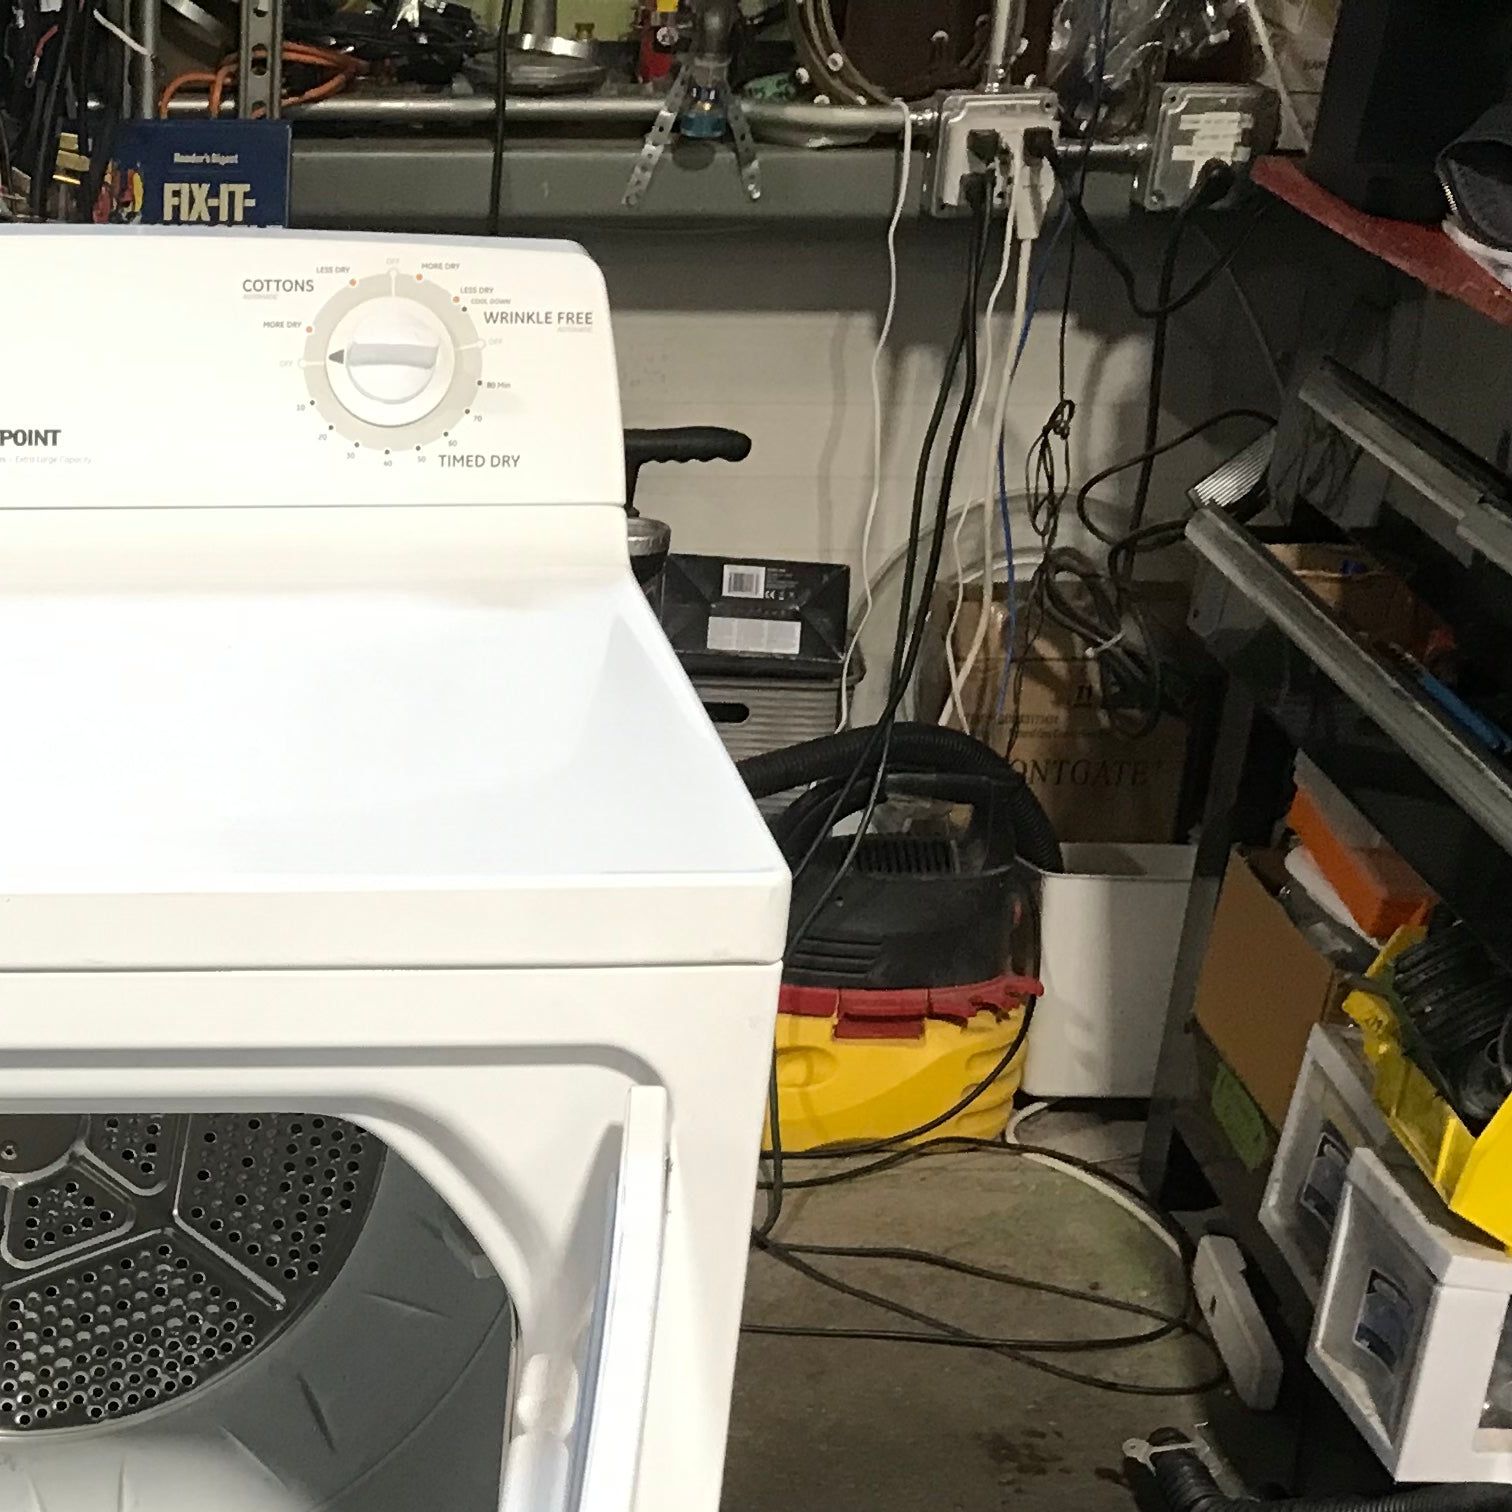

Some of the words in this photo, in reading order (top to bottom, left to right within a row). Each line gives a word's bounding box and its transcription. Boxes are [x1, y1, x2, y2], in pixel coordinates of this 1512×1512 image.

[316, 265, 334, 274] LESS
[335, 266, 351, 274] DRY
[421, 262, 444, 271] MORE
[445, 262, 461, 271] DRY
[243, 279, 314, 292] COTTONS
[460, 285, 478, 295] LESS
[479, 286, 495, 295] DRY
[484, 312, 552, 324] WRINKLE
[558, 312, 592, 324] FREE
[263, 320, 285, 329] MORE
[287, 320, 303, 329] DRY
[497, 381, 512, 389] Min
[297, 403, 307, 412] 10
[474, 414, 483, 423] 70
[318, 433, 328, 441] 20
[347, 451, 356, 460] 30
[438, 455, 485, 467] TIMED
[491, 455, 520, 467] DRY
[1010, 759, 1148, 786] ONTGATE
